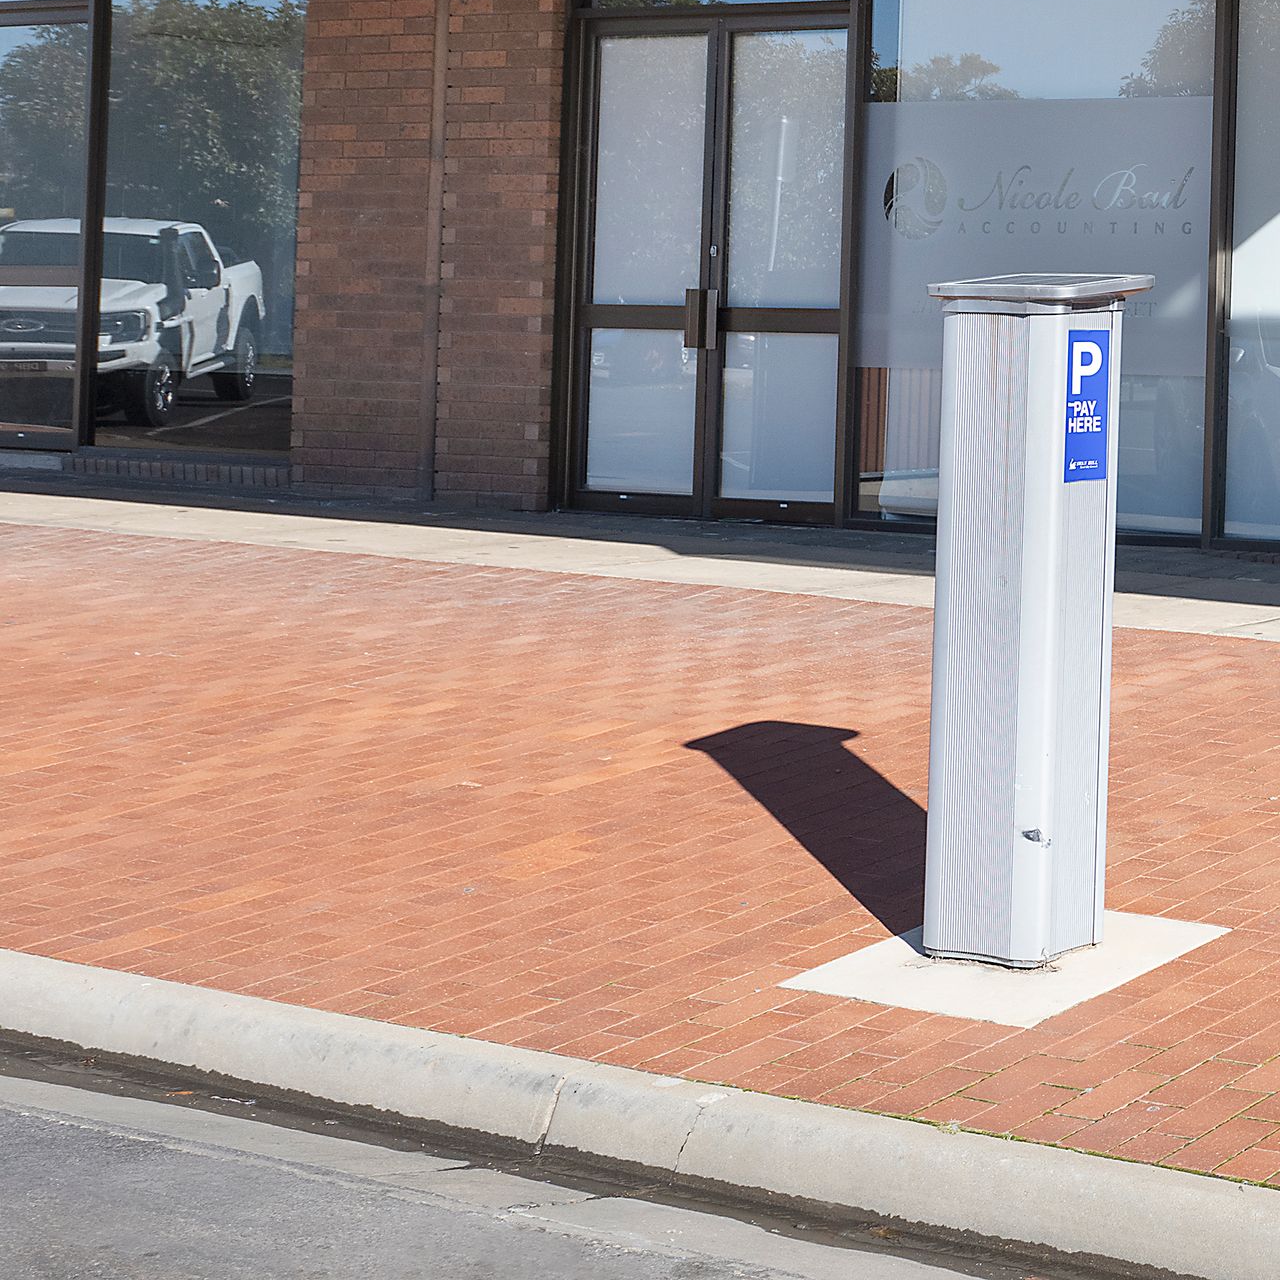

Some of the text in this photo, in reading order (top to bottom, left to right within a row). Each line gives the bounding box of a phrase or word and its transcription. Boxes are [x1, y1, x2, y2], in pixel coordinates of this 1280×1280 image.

[957, 165, 1082, 212] Nicole
[958, 221, 1192, 235] ACCOUNTING
[1071, 340, 1103, 395] P
[1073, 401, 1097, 417] PAY
[1068, 416, 1102, 434] HERE
